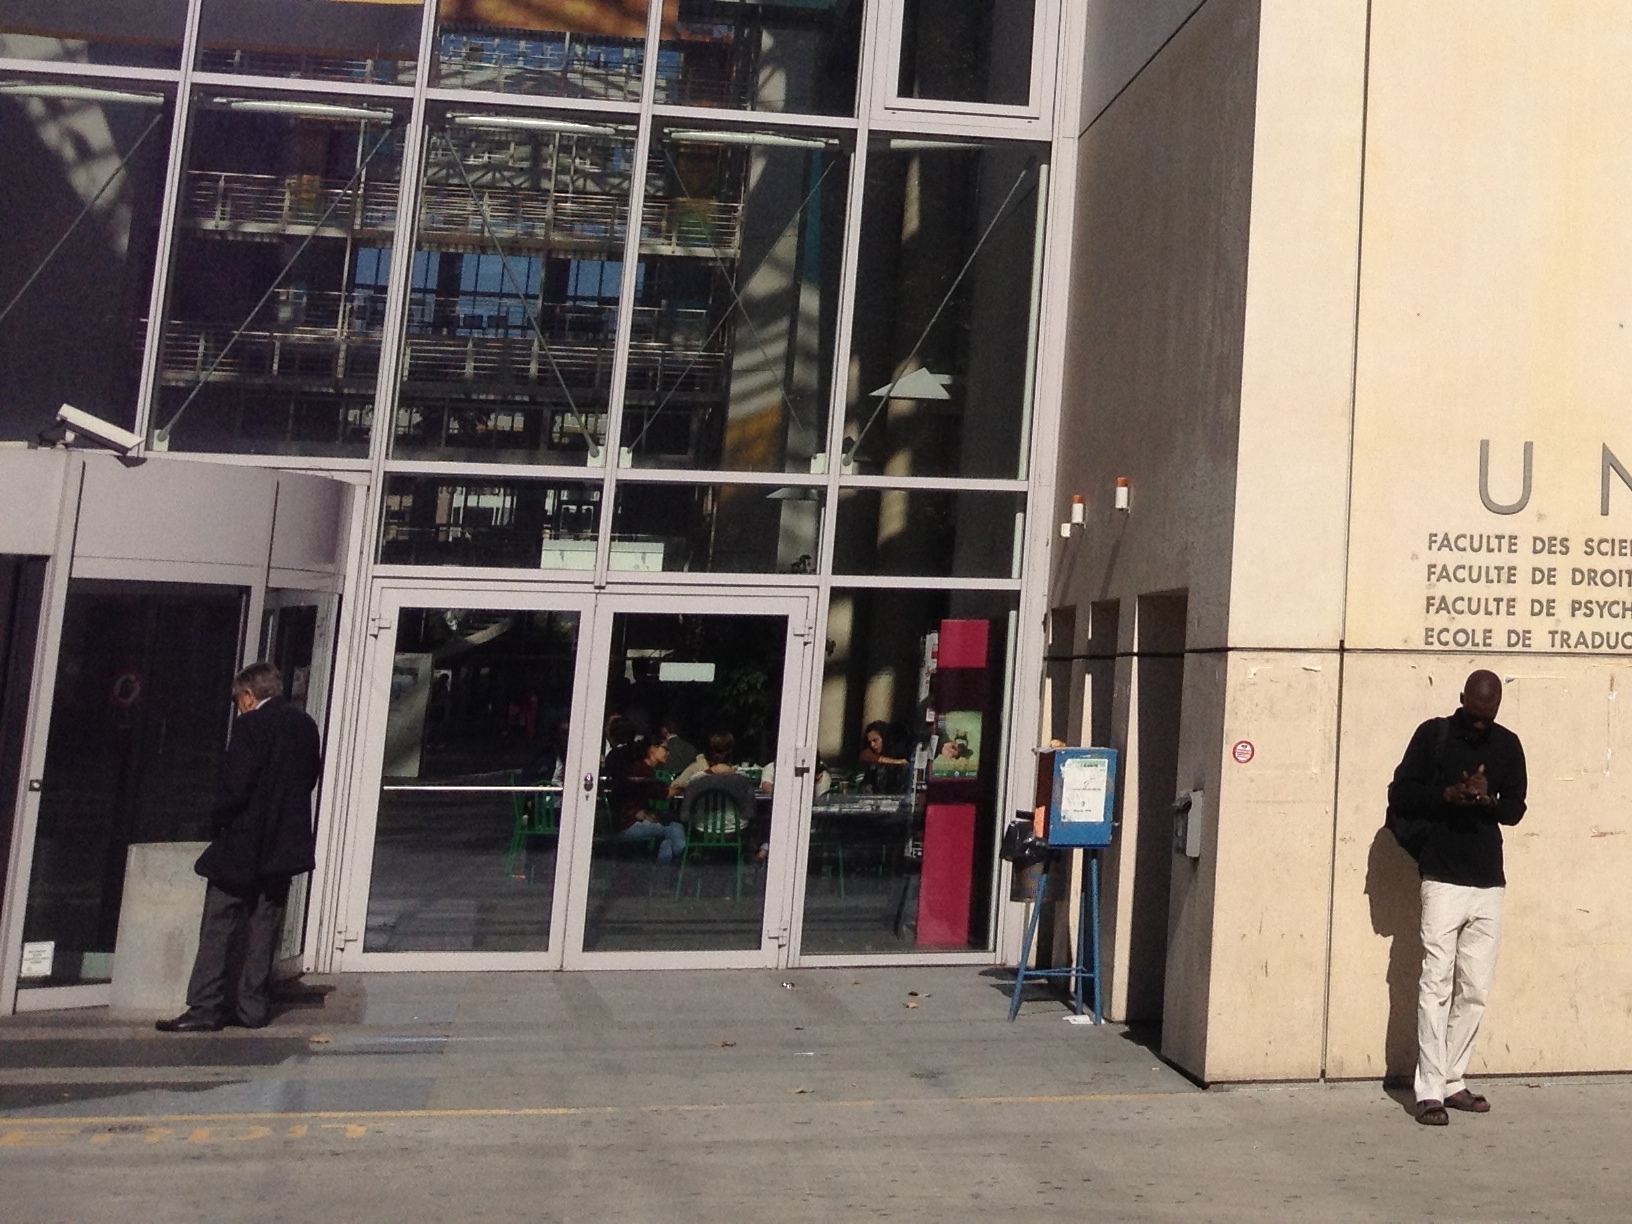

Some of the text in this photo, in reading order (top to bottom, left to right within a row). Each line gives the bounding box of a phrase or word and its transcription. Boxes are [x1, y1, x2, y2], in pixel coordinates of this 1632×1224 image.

[1428, 533, 1518, 554] FACULTE
[1532, 536, 1570, 556] DES
[1426, 563, 1517, 584] FACULTE
[1531, 566, 1557, 585] DE
[1425, 595, 1516, 616] FACULTE
[1530, 598, 1556, 617] DE
[1424, 627, 1493, 648] ECOLE
[1507, 629, 1532, 648] DE
